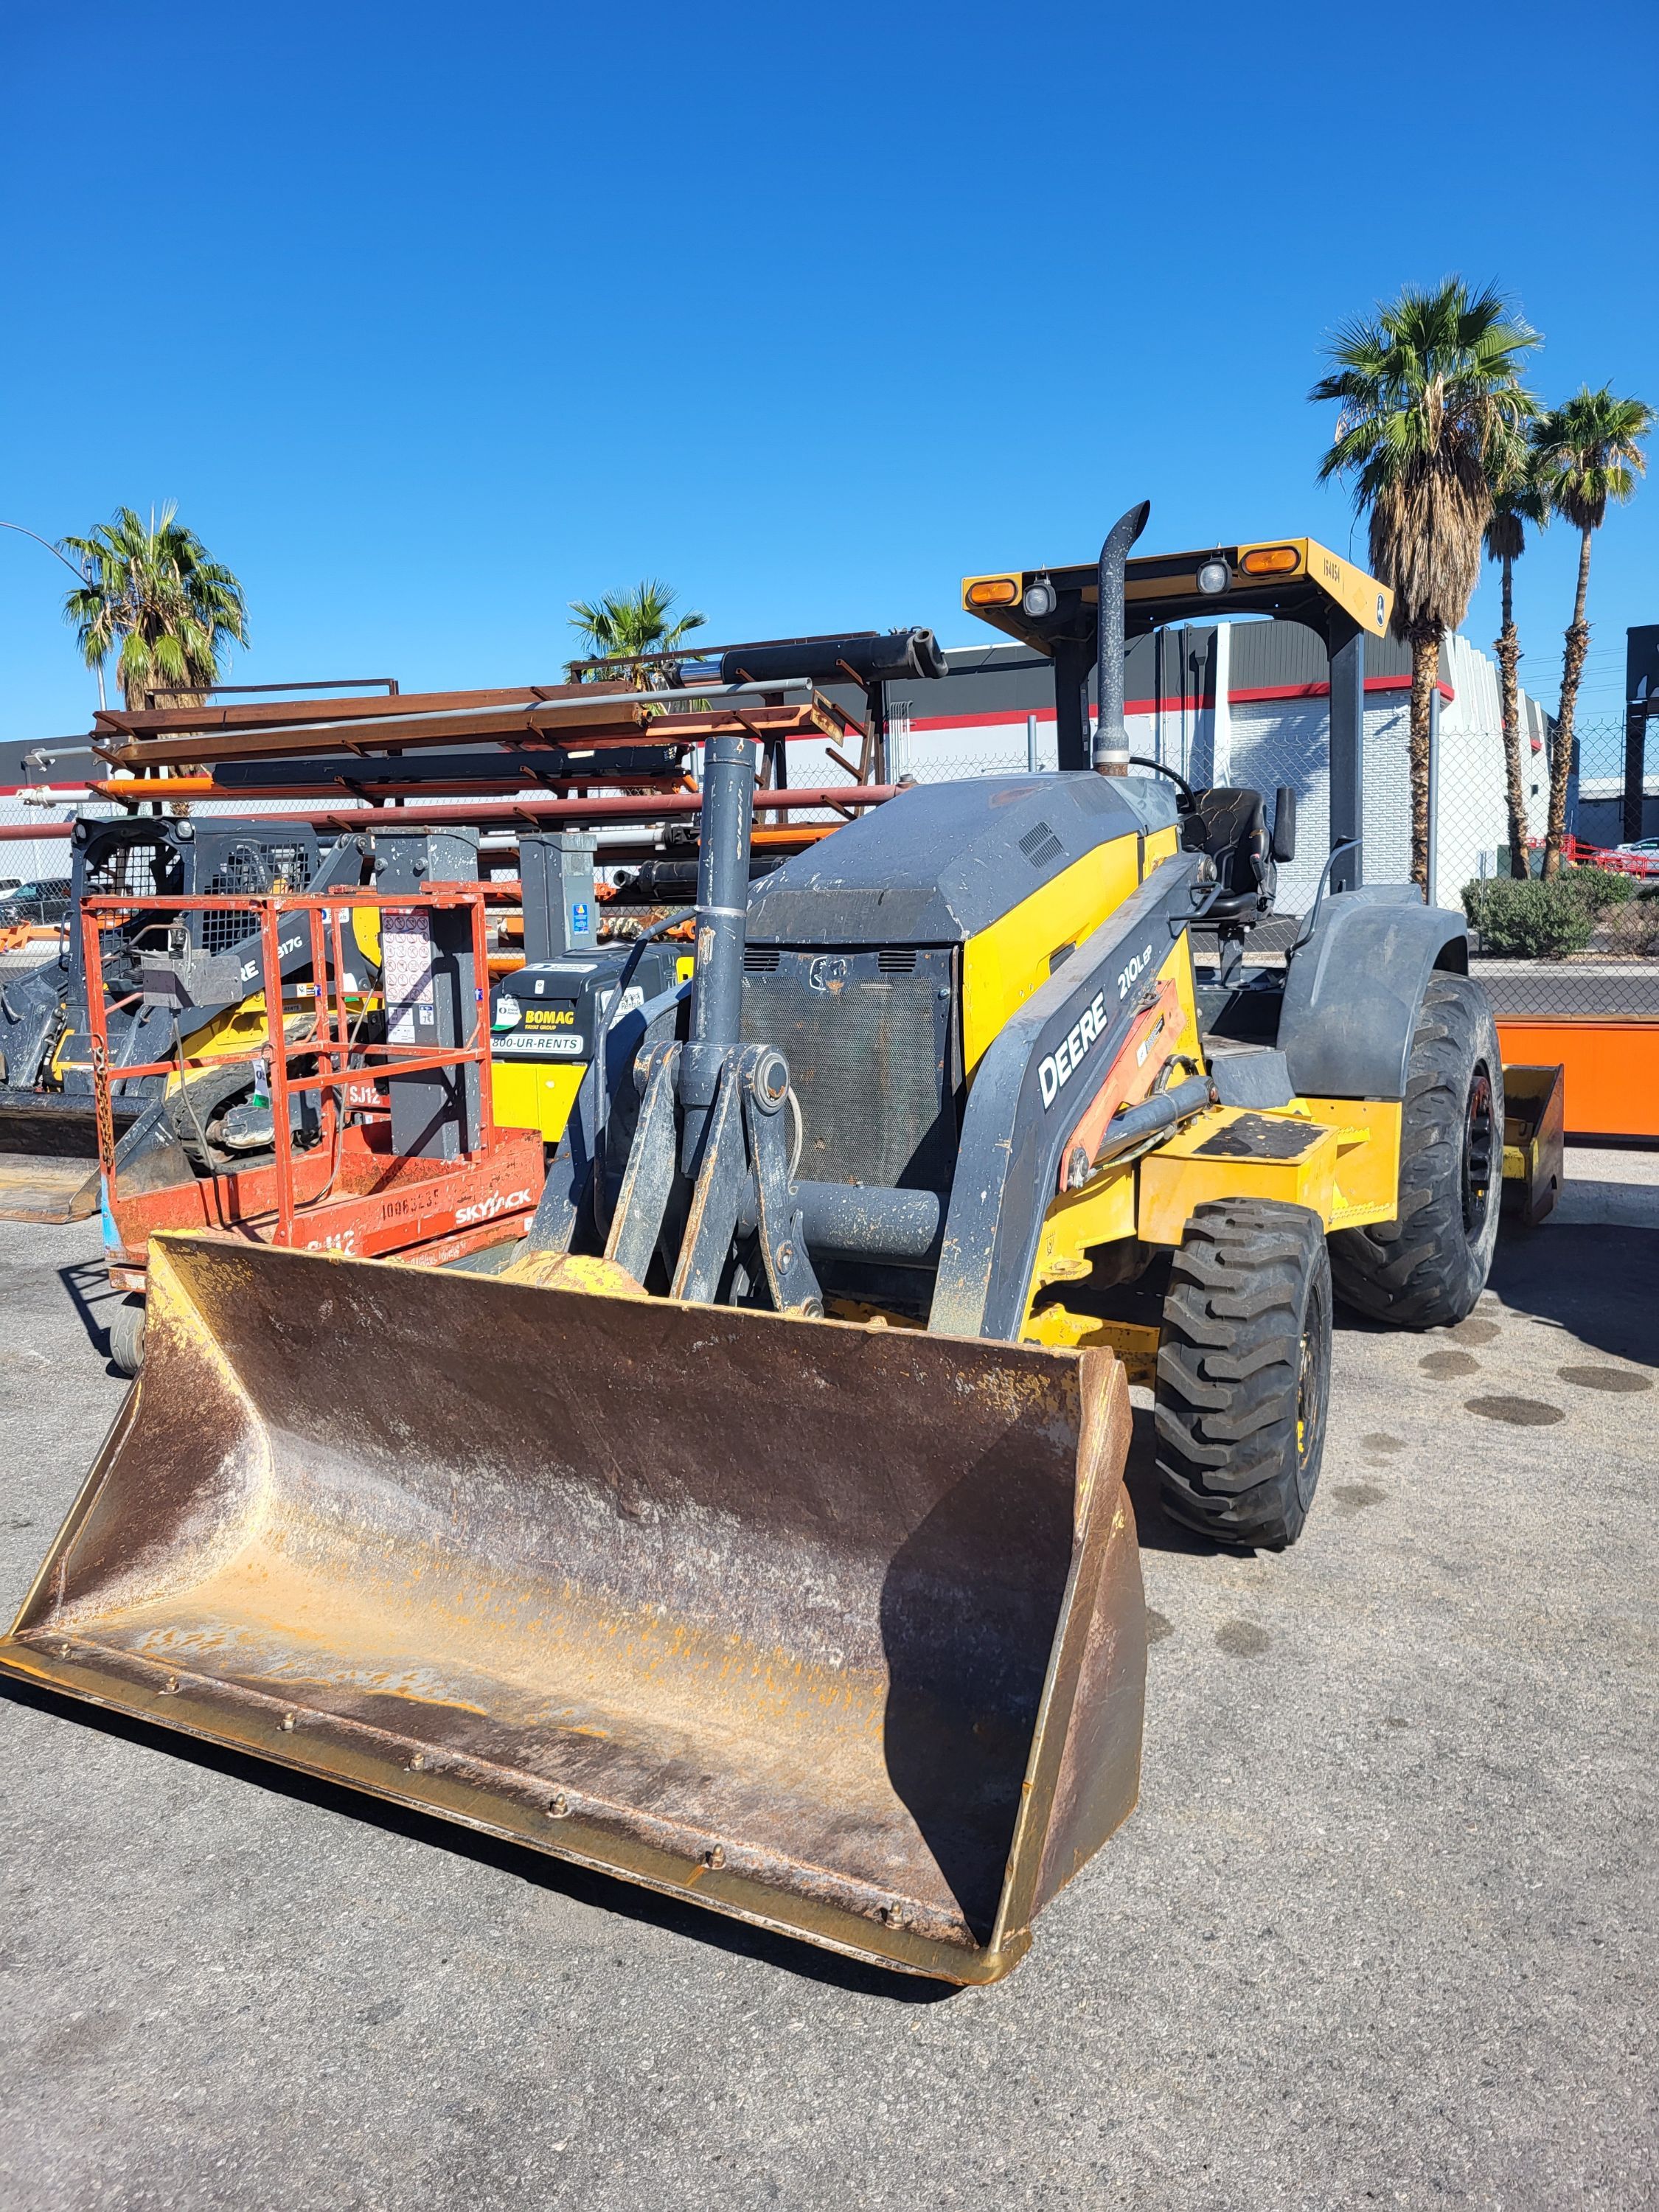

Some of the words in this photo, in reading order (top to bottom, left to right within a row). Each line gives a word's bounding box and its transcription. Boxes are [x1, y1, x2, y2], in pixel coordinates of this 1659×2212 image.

[525, 1010, 574, 1025] BOMAG
[1037, 991, 1107, 1110] DEERE
[349, 1085, 380, 1105] SJ12
